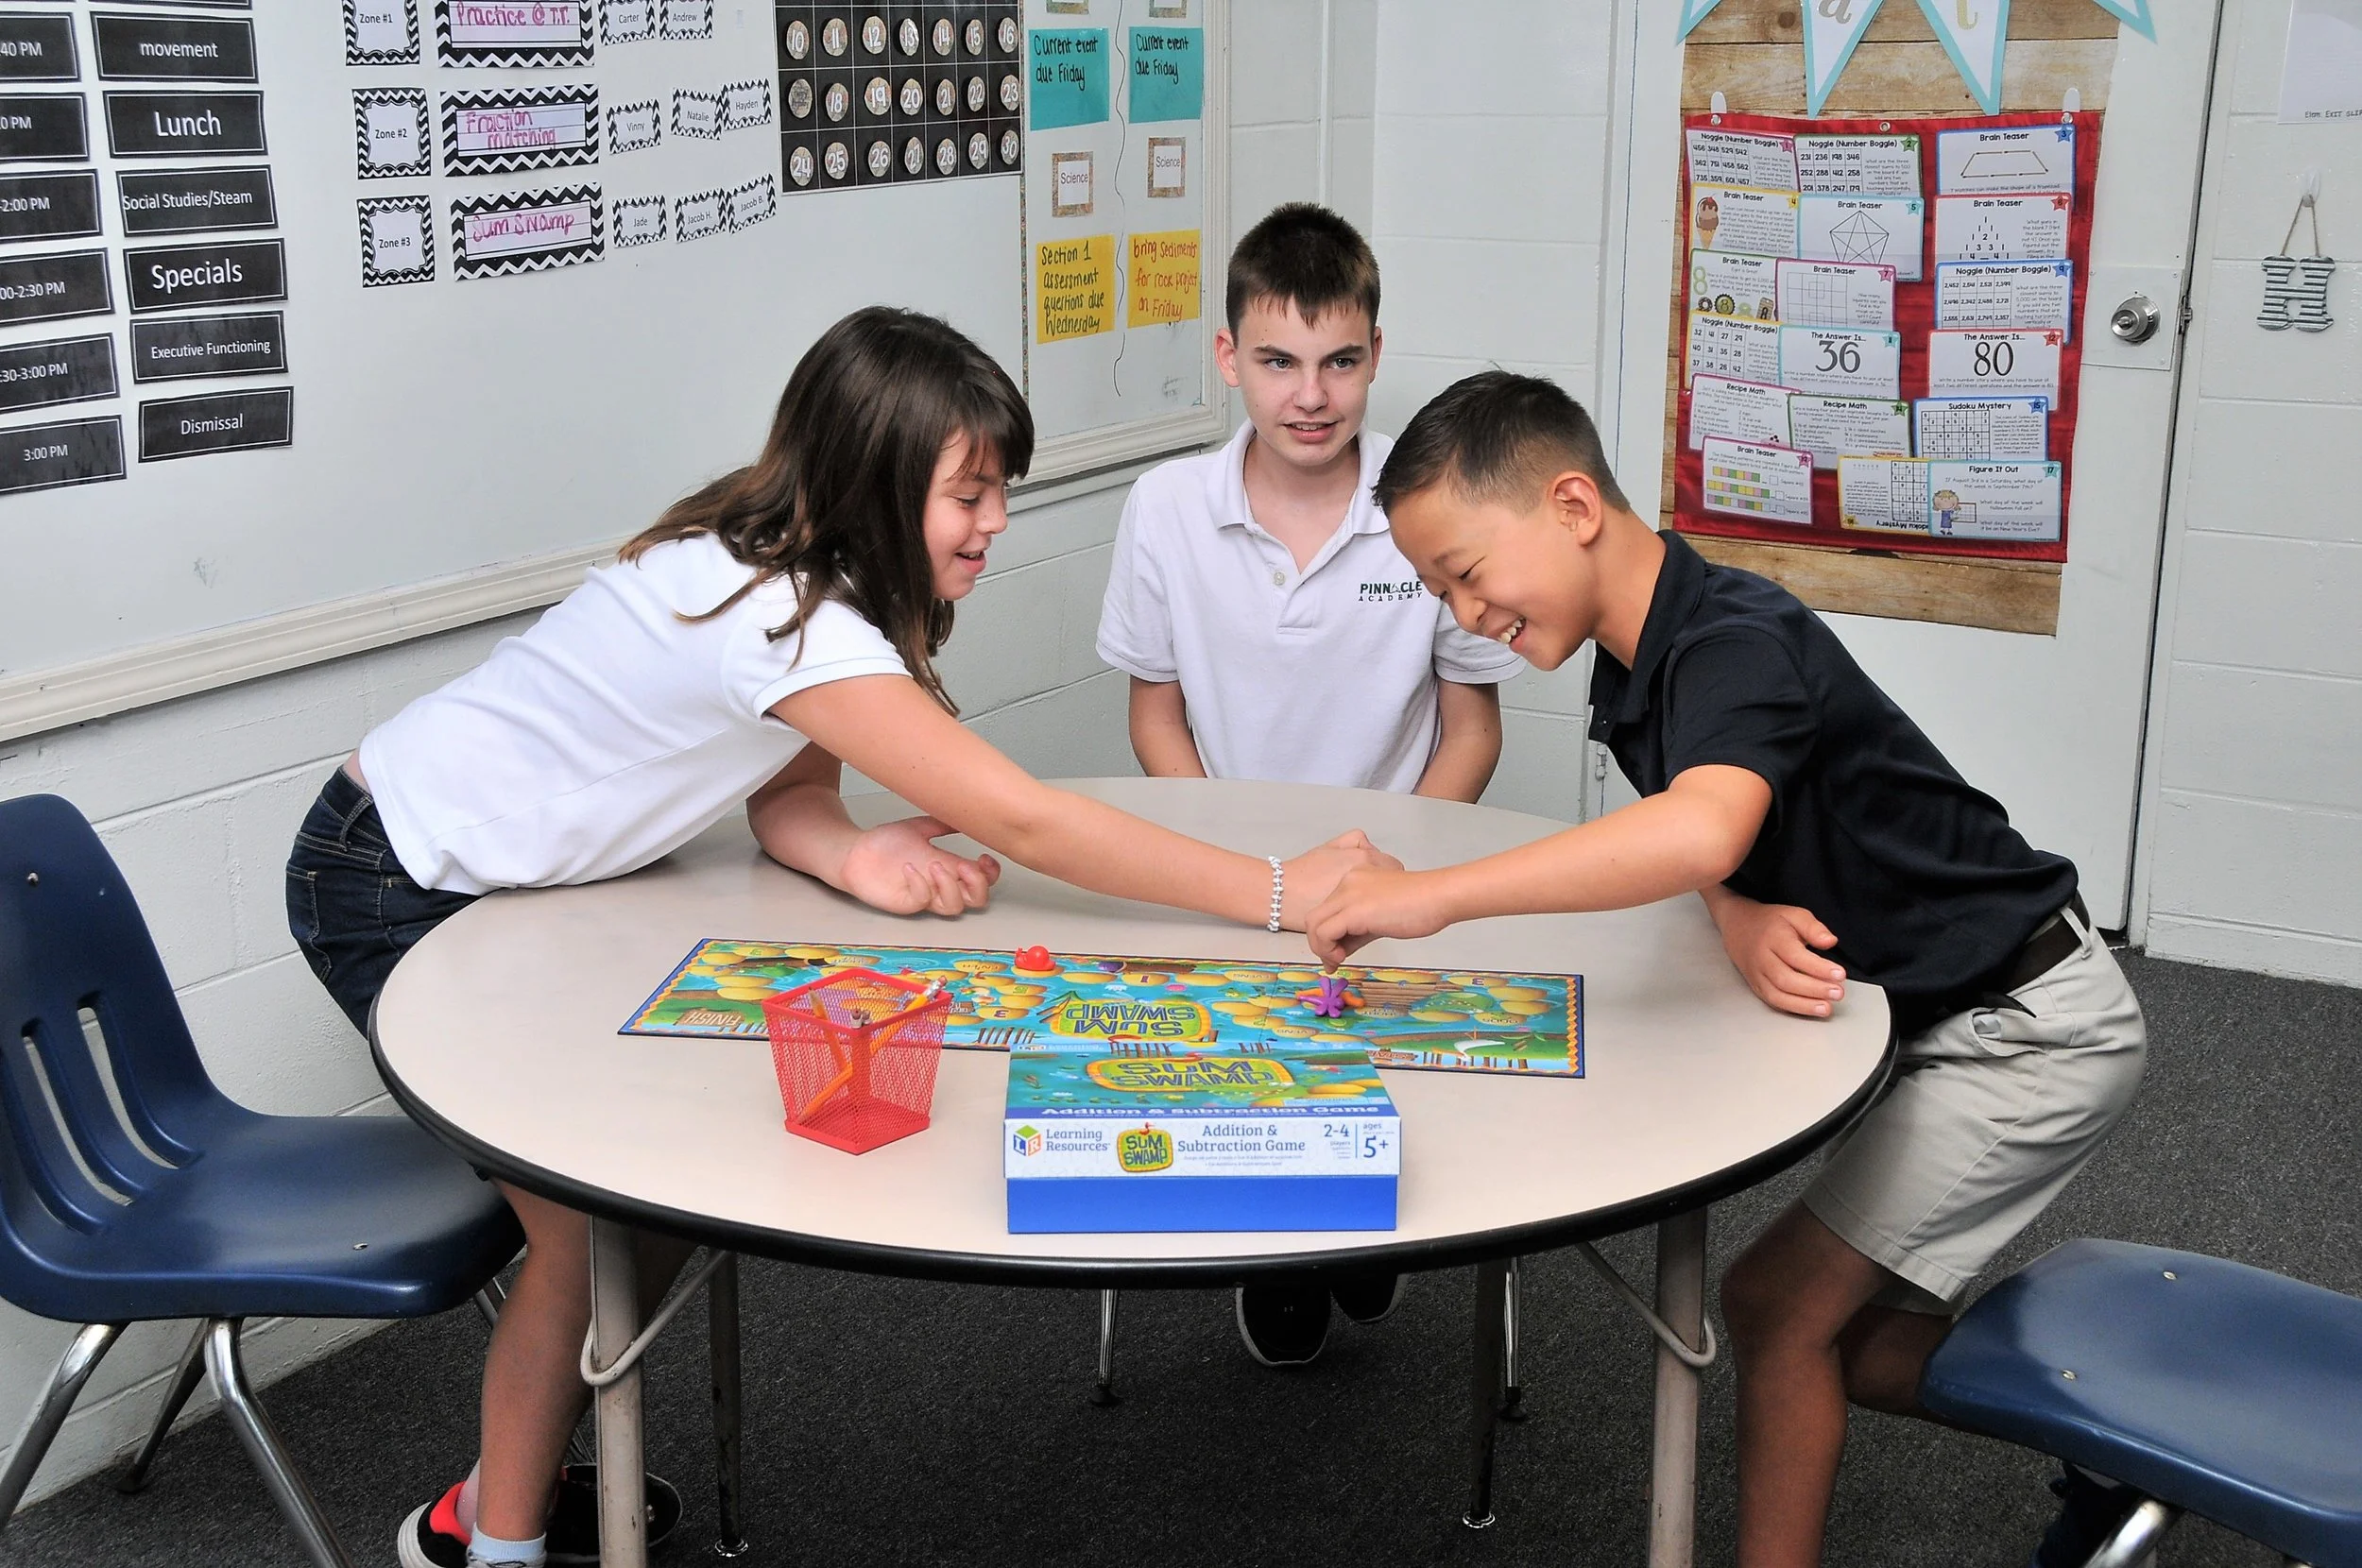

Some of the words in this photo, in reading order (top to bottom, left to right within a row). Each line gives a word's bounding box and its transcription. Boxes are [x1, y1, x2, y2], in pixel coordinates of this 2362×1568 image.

[359, 14, 381, 24] Zone
[382, 14, 393, 23] #1
[618, 13, 640, 24] Carter
[673, 12, 697, 23] Andrew
[791, 29, 803, 53] 10
[830, 27, 839, 49] 11
[868, 26, 881, 47] 12
[904, 28, 916, 46] 13
[938, 27, 950, 47] 14
[970, 27, 981, 47] 15
[1003, 26, 1015, 44] 16
[1137, 33, 1164, 52] Current
[1167, 36, 1189, 50] event
[0, 43, 17, 57] 40
[20, 42, 43, 57] PM
[140, 42, 218, 59] movement
[1034, 35, 1072, 56] Current
[1076, 37, 1099, 54] event
[1036, 63, 1053, 83] due
[1059, 63, 1086, 91] Friday
[1136, 59, 1150, 75] due
[1154, 59, 1178, 84] Friday
[871, 87, 886, 109] 19
[902, 89, 920, 108] 20
[941, 88, 951, 108] 21
[969, 85, 983, 105] 22
[1003, 82, 1018, 103] 23
[735, 99, 759, 111] Hayden
[830, 92, 842, 112] 18
[11, 116, 32, 129] PM
[154, 109, 222, 137] Lunch
[687, 111, 710, 122] Natalie
[375, 129, 395, 139] Zone
[397, 128, 407, 138] #2
[626, 121, 645, 132] Vinny
[1808, 140, 1834, 148] Noggle
[1979, 133, 2001, 142] Brain
[2003, 132, 2029, 141] Teaser
[970, 140, 986, 161] 29
[1003, 136, 1018, 159] 30
[828, 151, 846, 174] 25
[871, 147, 889, 168] 26
[908, 145, 920, 168] 27
[939, 145, 954, 167] 28
[1155, 156, 1181, 168] Science
[793, 157, 812, 179] 24
[1060, 172, 1088, 184] Science
[31, 196, 50, 211] PM
[123, 194, 160, 211] Social
[163, 190, 253, 209] Studies/Steam
[1742, 193, 1764, 201] Teaser
[1973, 199, 1994, 208] Brain
[740, 198, 758, 213] Jacob
[633, 217, 648, 228] Jade
[688, 213, 705, 225] Jacob
[379, 238, 400, 248] Zone
[402, 237, 411, 247] #3
[1042, 246, 1078, 265] Section
[1741, 259, 1763, 267] Teaser
[151, 258, 243, 294] Specials
[1136, 267, 1151, 287] for
[1813, 265, 1832, 274] Brain
[1834, 266, 1857, 275] Teaser
[1956, 267, 1983, 276] Noggle
[1044, 267, 1099, 290] assessment
[46, 281, 66, 296] PM
[2256, 256, 2336, 332] H
[1044, 295, 1084, 316] questions
[1088, 290, 1104, 310] due
[1153, 298, 1183, 321] Friday
[1824, 332, 1852, 340] Answer
[151, 346, 204, 360] Executive
[206, 340, 271, 356] Functioning
[1815, 340, 1861, 373] 36
[1974, 341, 2014, 376] 80
[48, 363, 68, 376] PM
[1726, 383, 1748, 393] Recipe
[1749, 386, 1766, 395] Math
[1823, 401, 1847, 409] Recipe
[1848, 401, 1868, 410] Math
[1977, 402, 2012, 411] Mystery
[180, 414, 244, 436] Dismissal
[24, 447, 48, 462] 3:00
[49, 444, 69, 458] PM
[1737, 445, 1754, 454] Brain
[1755, 448, 1777, 457] Teaser
[1358, 592, 1422, 602] ACADEMY
[1120, 1061, 1255, 1074] SUM
[1110, 1073, 1274, 1086] SWAMP
[1171, 1106, 1308, 1115] Subtraction
[1046, 1129, 1103, 1141] Learning
[1202, 1125, 1263, 1137] Addition
[1266, 1125, 1277, 1136] &
[1324, 1123, 1349, 1137] 2-4
[1046, 1141, 1108, 1151] Resources
[1126, 1134, 1163, 1150] SUM
[1178, 1140, 1261, 1152] Subtraction
[1265, 1140, 1306, 1151] Game
[1124, 1148, 1168, 1166] SWAMP
